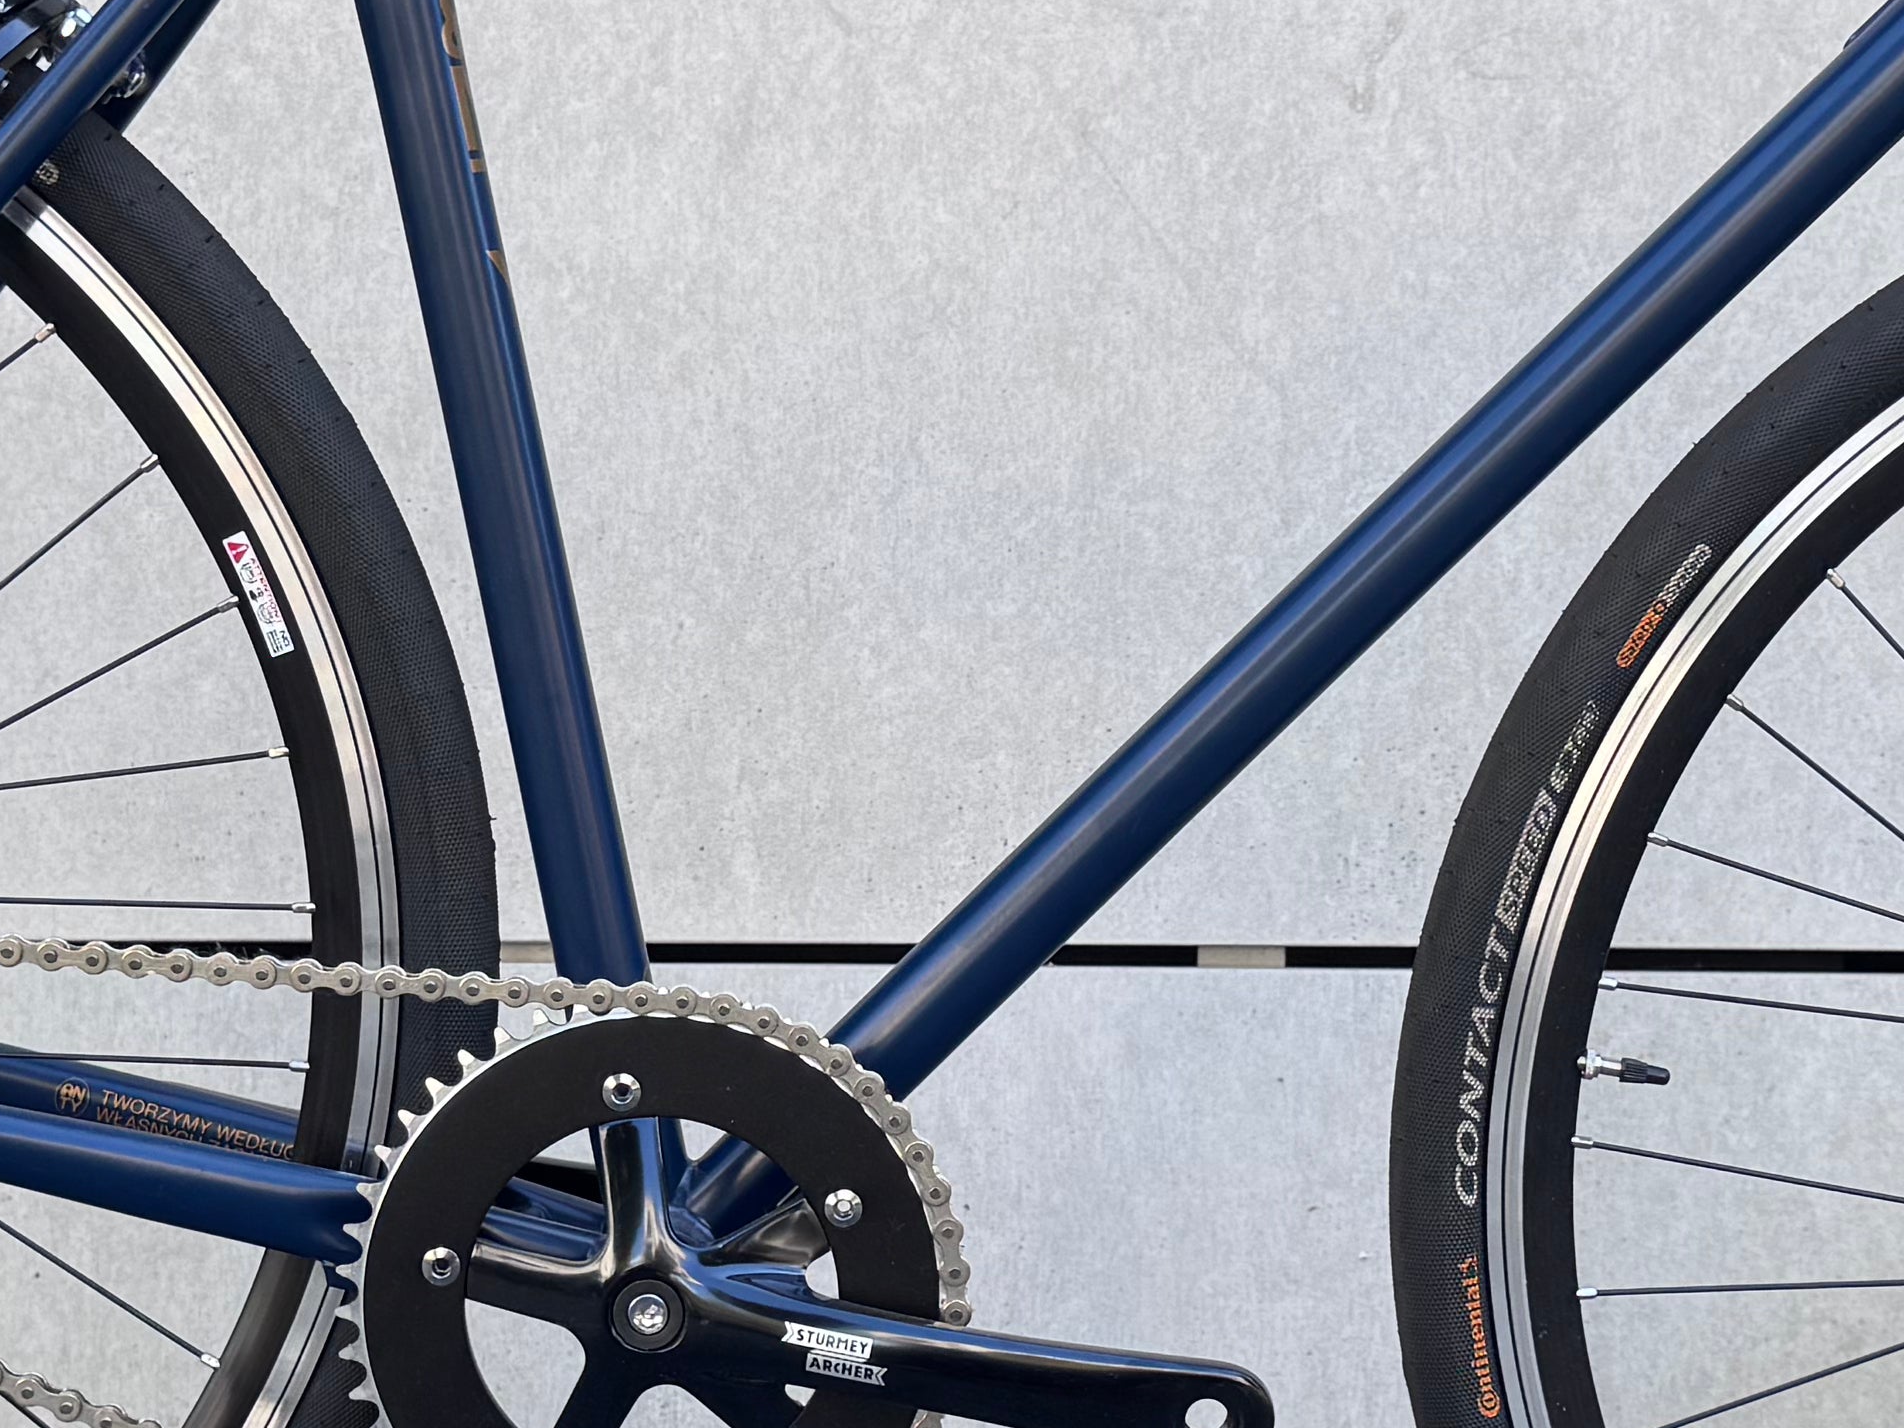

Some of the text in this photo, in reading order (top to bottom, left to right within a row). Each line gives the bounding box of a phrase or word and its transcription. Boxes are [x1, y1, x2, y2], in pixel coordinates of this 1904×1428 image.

[1457, 926, 1516, 1207] CONTACT
[102, 1088, 213, 1134] TWORZYMY
[796, 1328, 869, 1355] STURMEY
[1463, 1275, 1501, 1419] Continental
[808, 1356, 875, 1381] ARCHER
